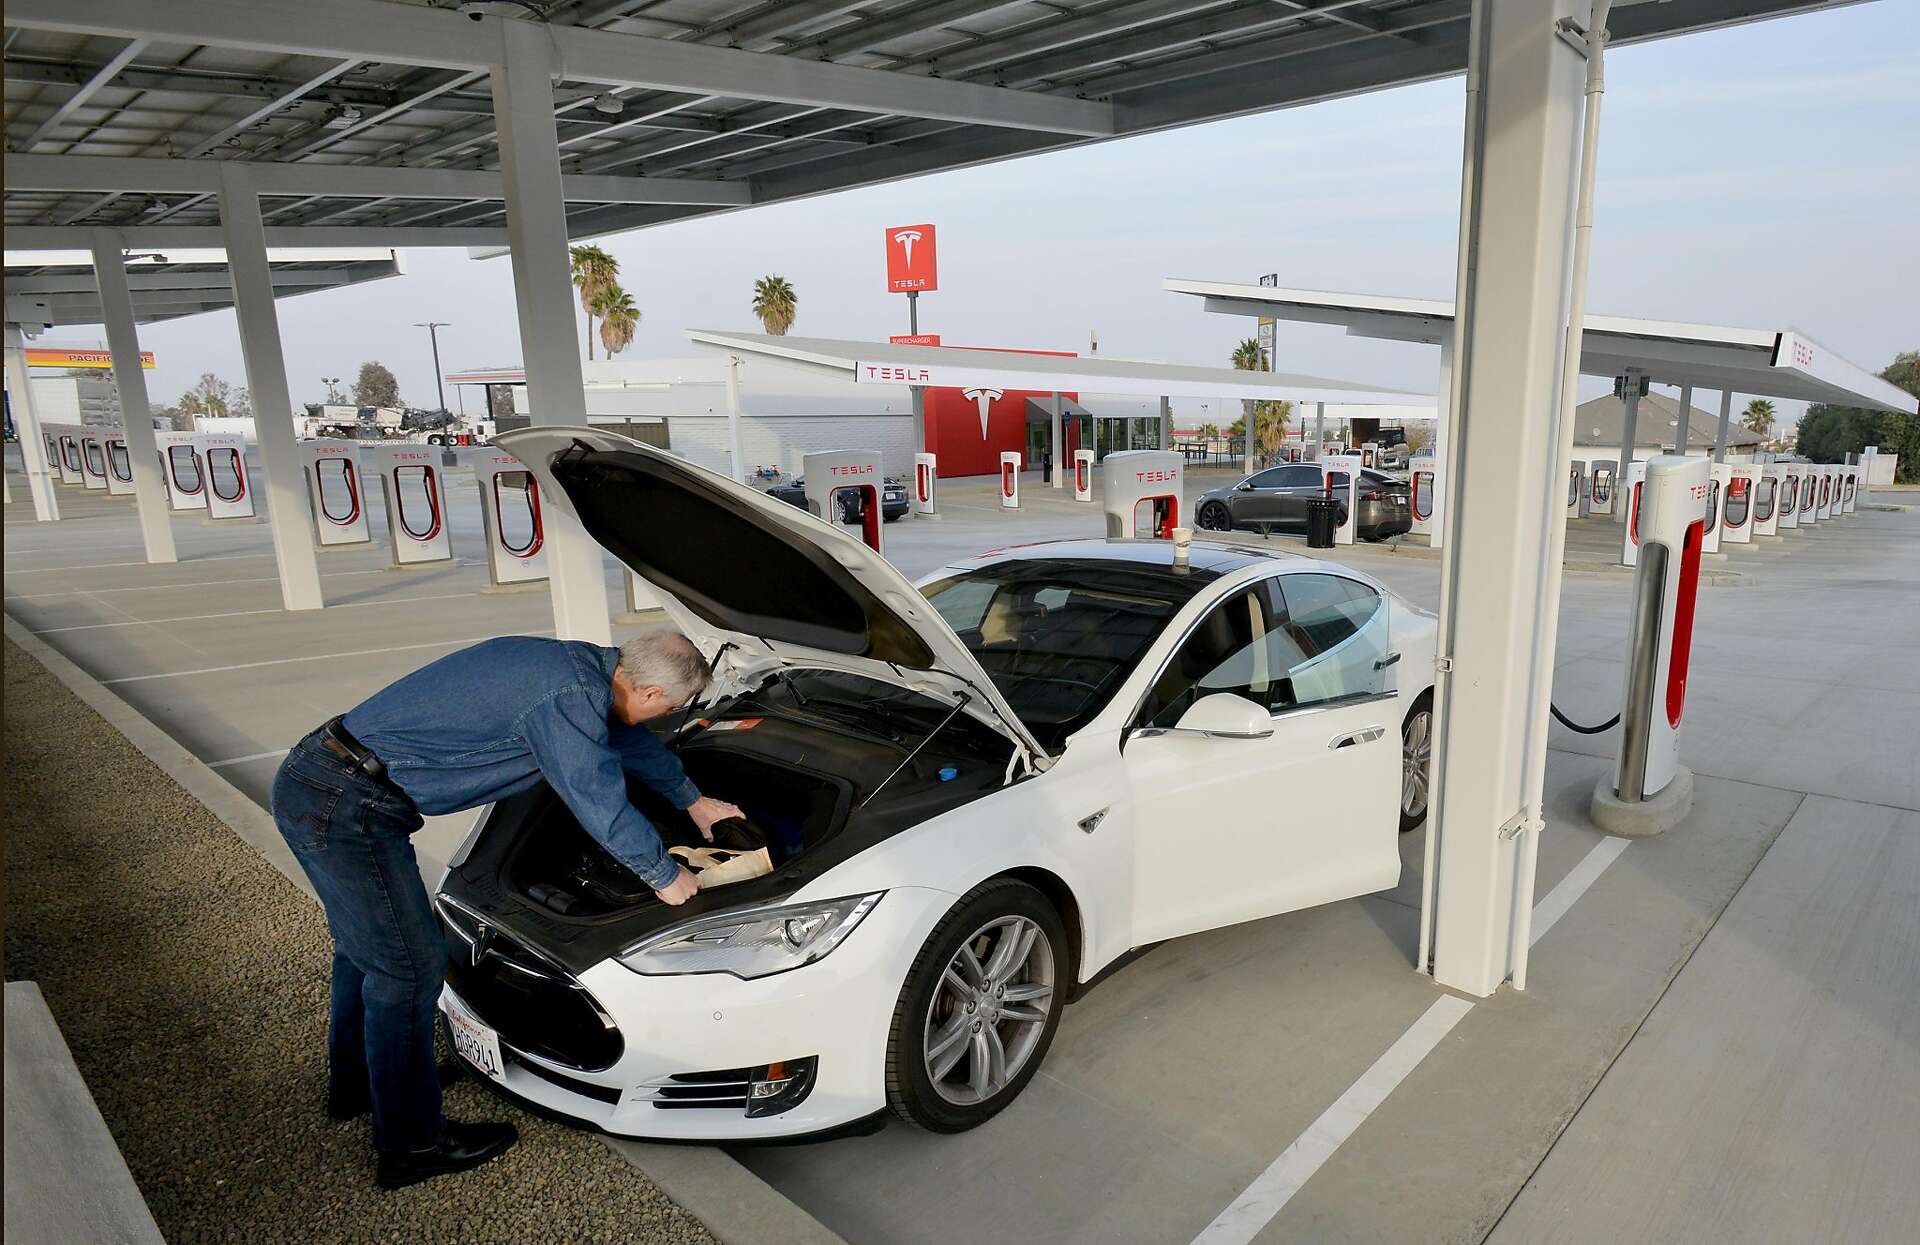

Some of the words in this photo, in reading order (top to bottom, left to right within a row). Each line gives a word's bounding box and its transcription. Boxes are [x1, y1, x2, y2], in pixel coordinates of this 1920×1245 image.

[894, 278, 925, 288] TESLA
[1793, 339, 1814, 366] TESLA
[866, 366, 929, 381] TESLA
[831, 464, 873, 475] TESLA
[1136, 470, 1177, 484] TESLA
